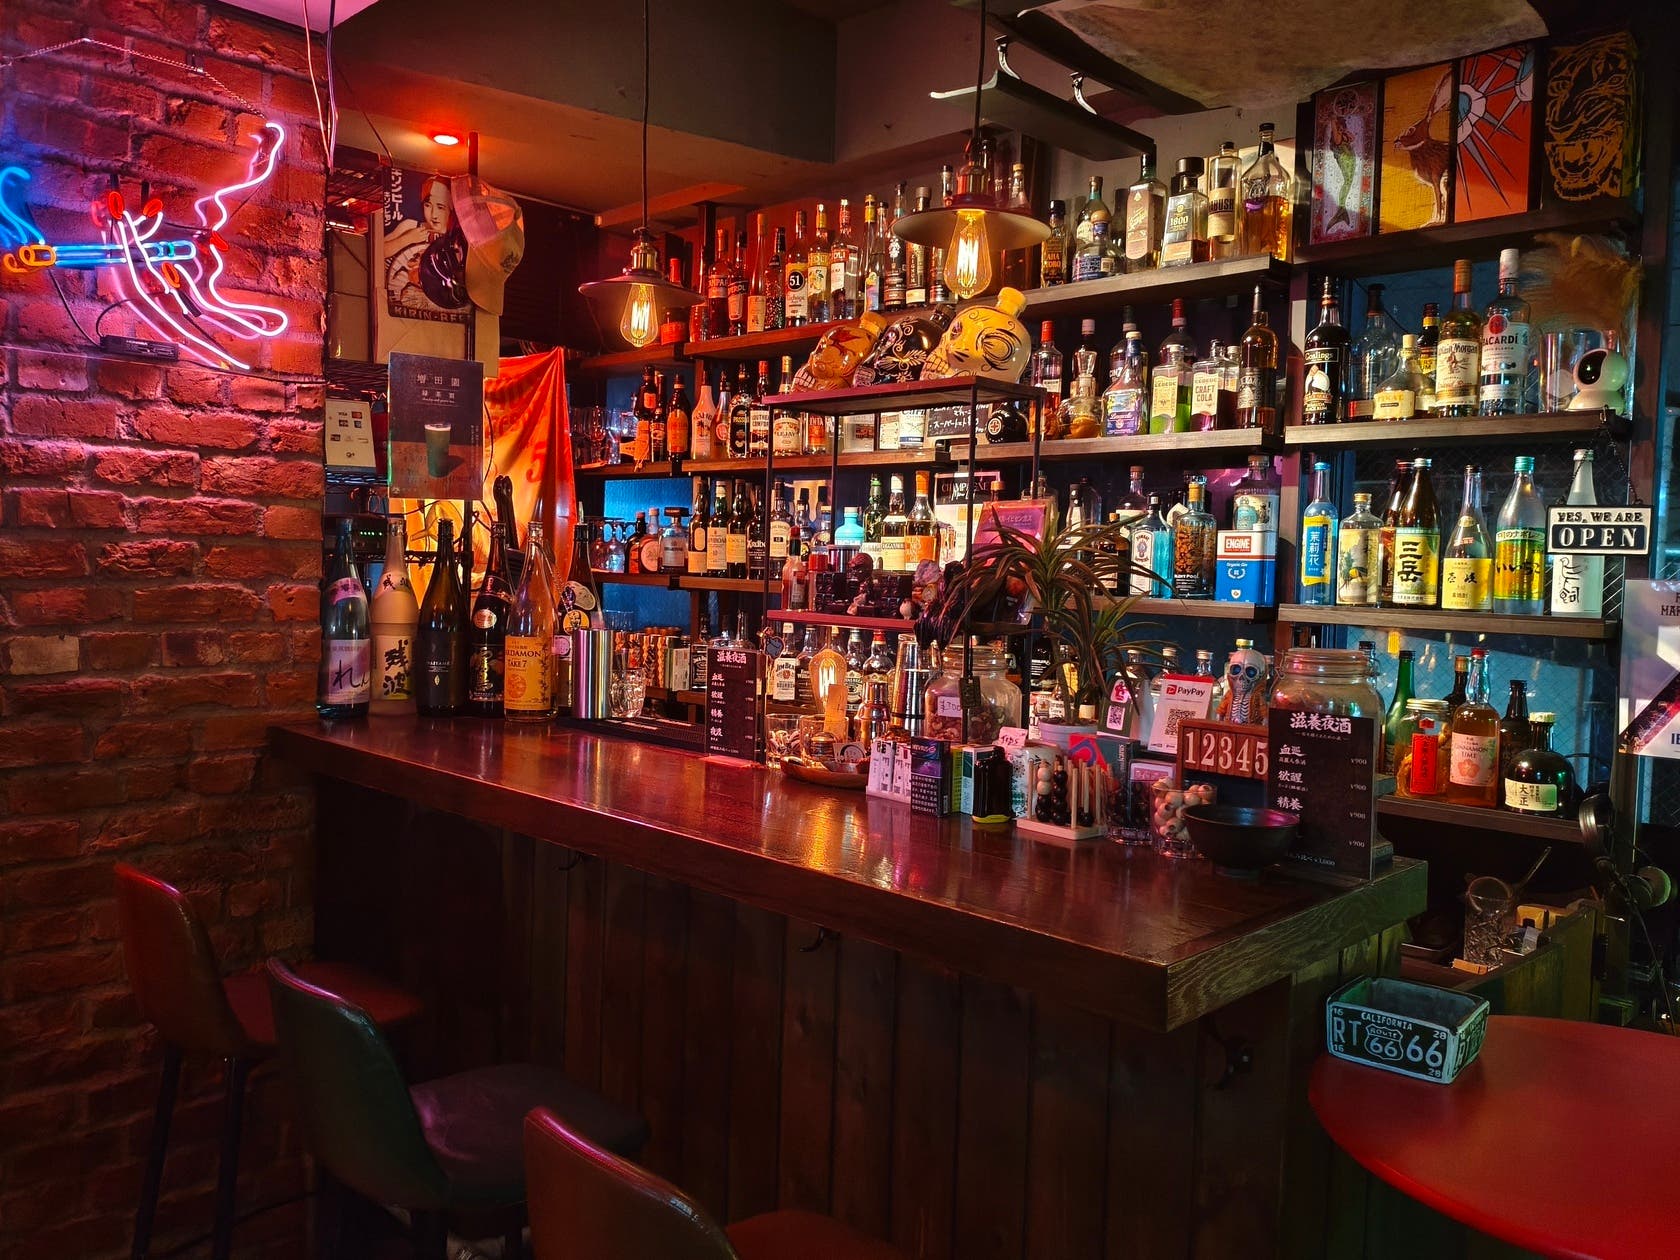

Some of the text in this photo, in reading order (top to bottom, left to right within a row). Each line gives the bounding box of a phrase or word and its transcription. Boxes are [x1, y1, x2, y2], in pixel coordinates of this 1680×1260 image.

[1170, 217, 1188, 225] 1800
[789, 275, 801, 287] 51
[1195, 385, 1215, 394] CRAFT
[1196, 393, 1213, 402] COLA
[809, 417, 824, 426] DITA
[1558, 511, 1643, 524] YES, WE ARE
[1559, 525, 1639, 548] OPEN
[1225, 538, 1251, 549] ENGINE
[1309, 531, 1321, 566] 茉莉花
[1397, 541, 1424, 583] 三岳
[522, 659, 528, 667] 7
[1177, 686, 1206, 698] PayPay
[1289, 711, 1353, 735] 滋養夜酒
[1184, 731, 1270, 777] 12345
[1519, 784, 1529, 807] 大正
[1333, 1007, 1345, 1016] 16
[1361, 1012, 1413, 1031] CALIFORNIA
[1370, 1027, 1398, 1039] ROUTE
[1432, 1030, 1447, 1040] 28
[1332, 1016, 1443, 1068] RT 66
[1369, 1037, 1398, 1058] 66
[1333, 1044, 1345, 1053] 16
[1427, 1067, 1442, 1078] 28
